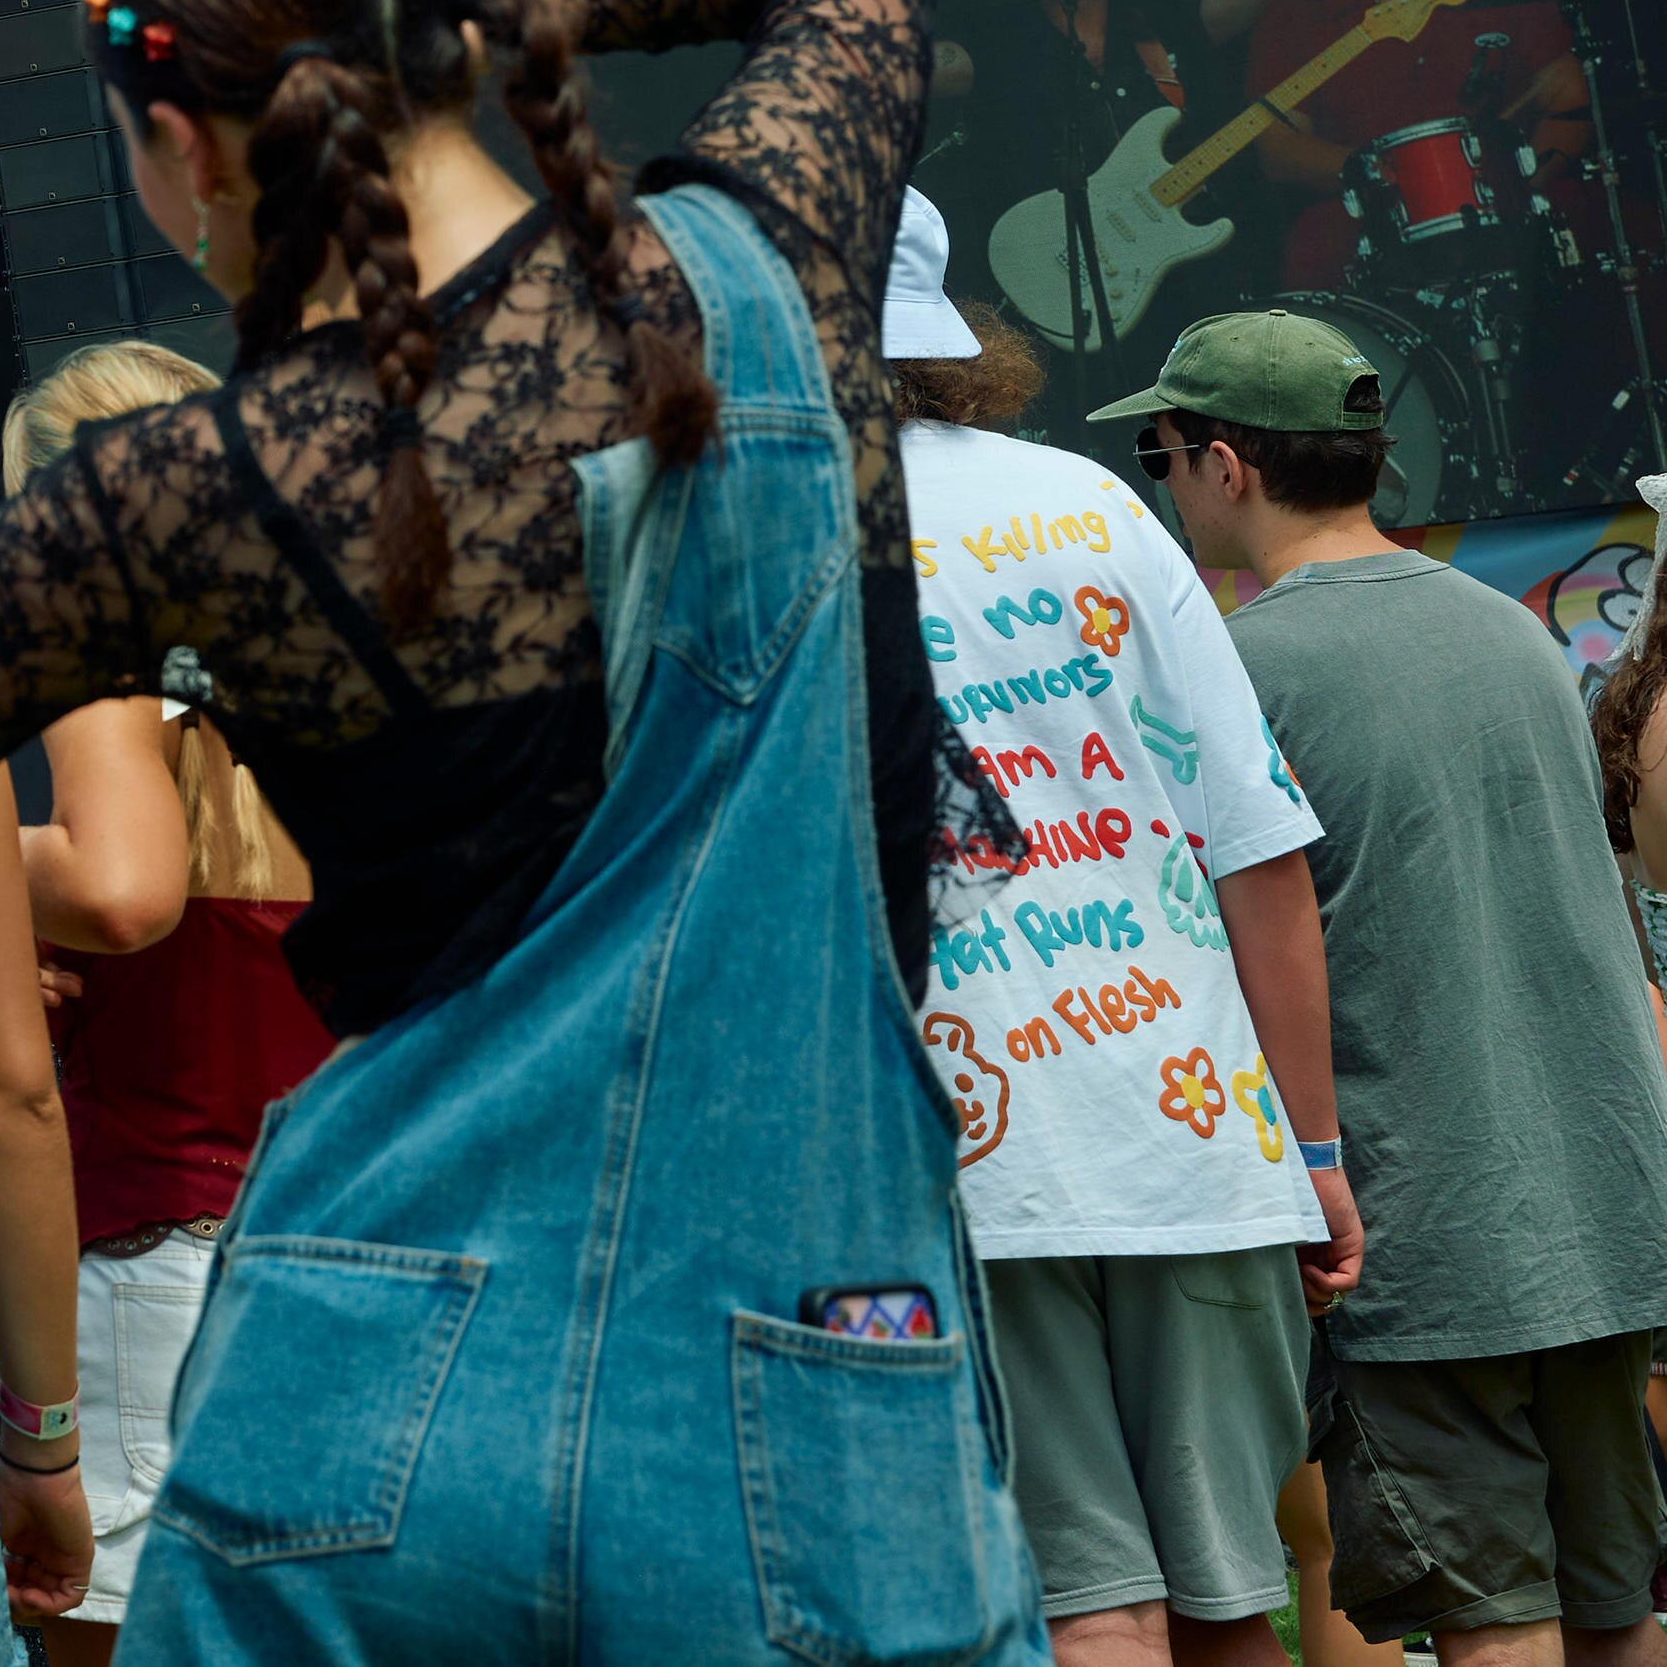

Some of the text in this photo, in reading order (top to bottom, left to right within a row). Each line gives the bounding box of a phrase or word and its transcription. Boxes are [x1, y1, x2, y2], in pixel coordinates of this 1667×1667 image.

[1081, 732, 1125, 781] A
[1014, 898, 1145, 967] Runs
[1006, 965, 1181, 1063] on Flesh
